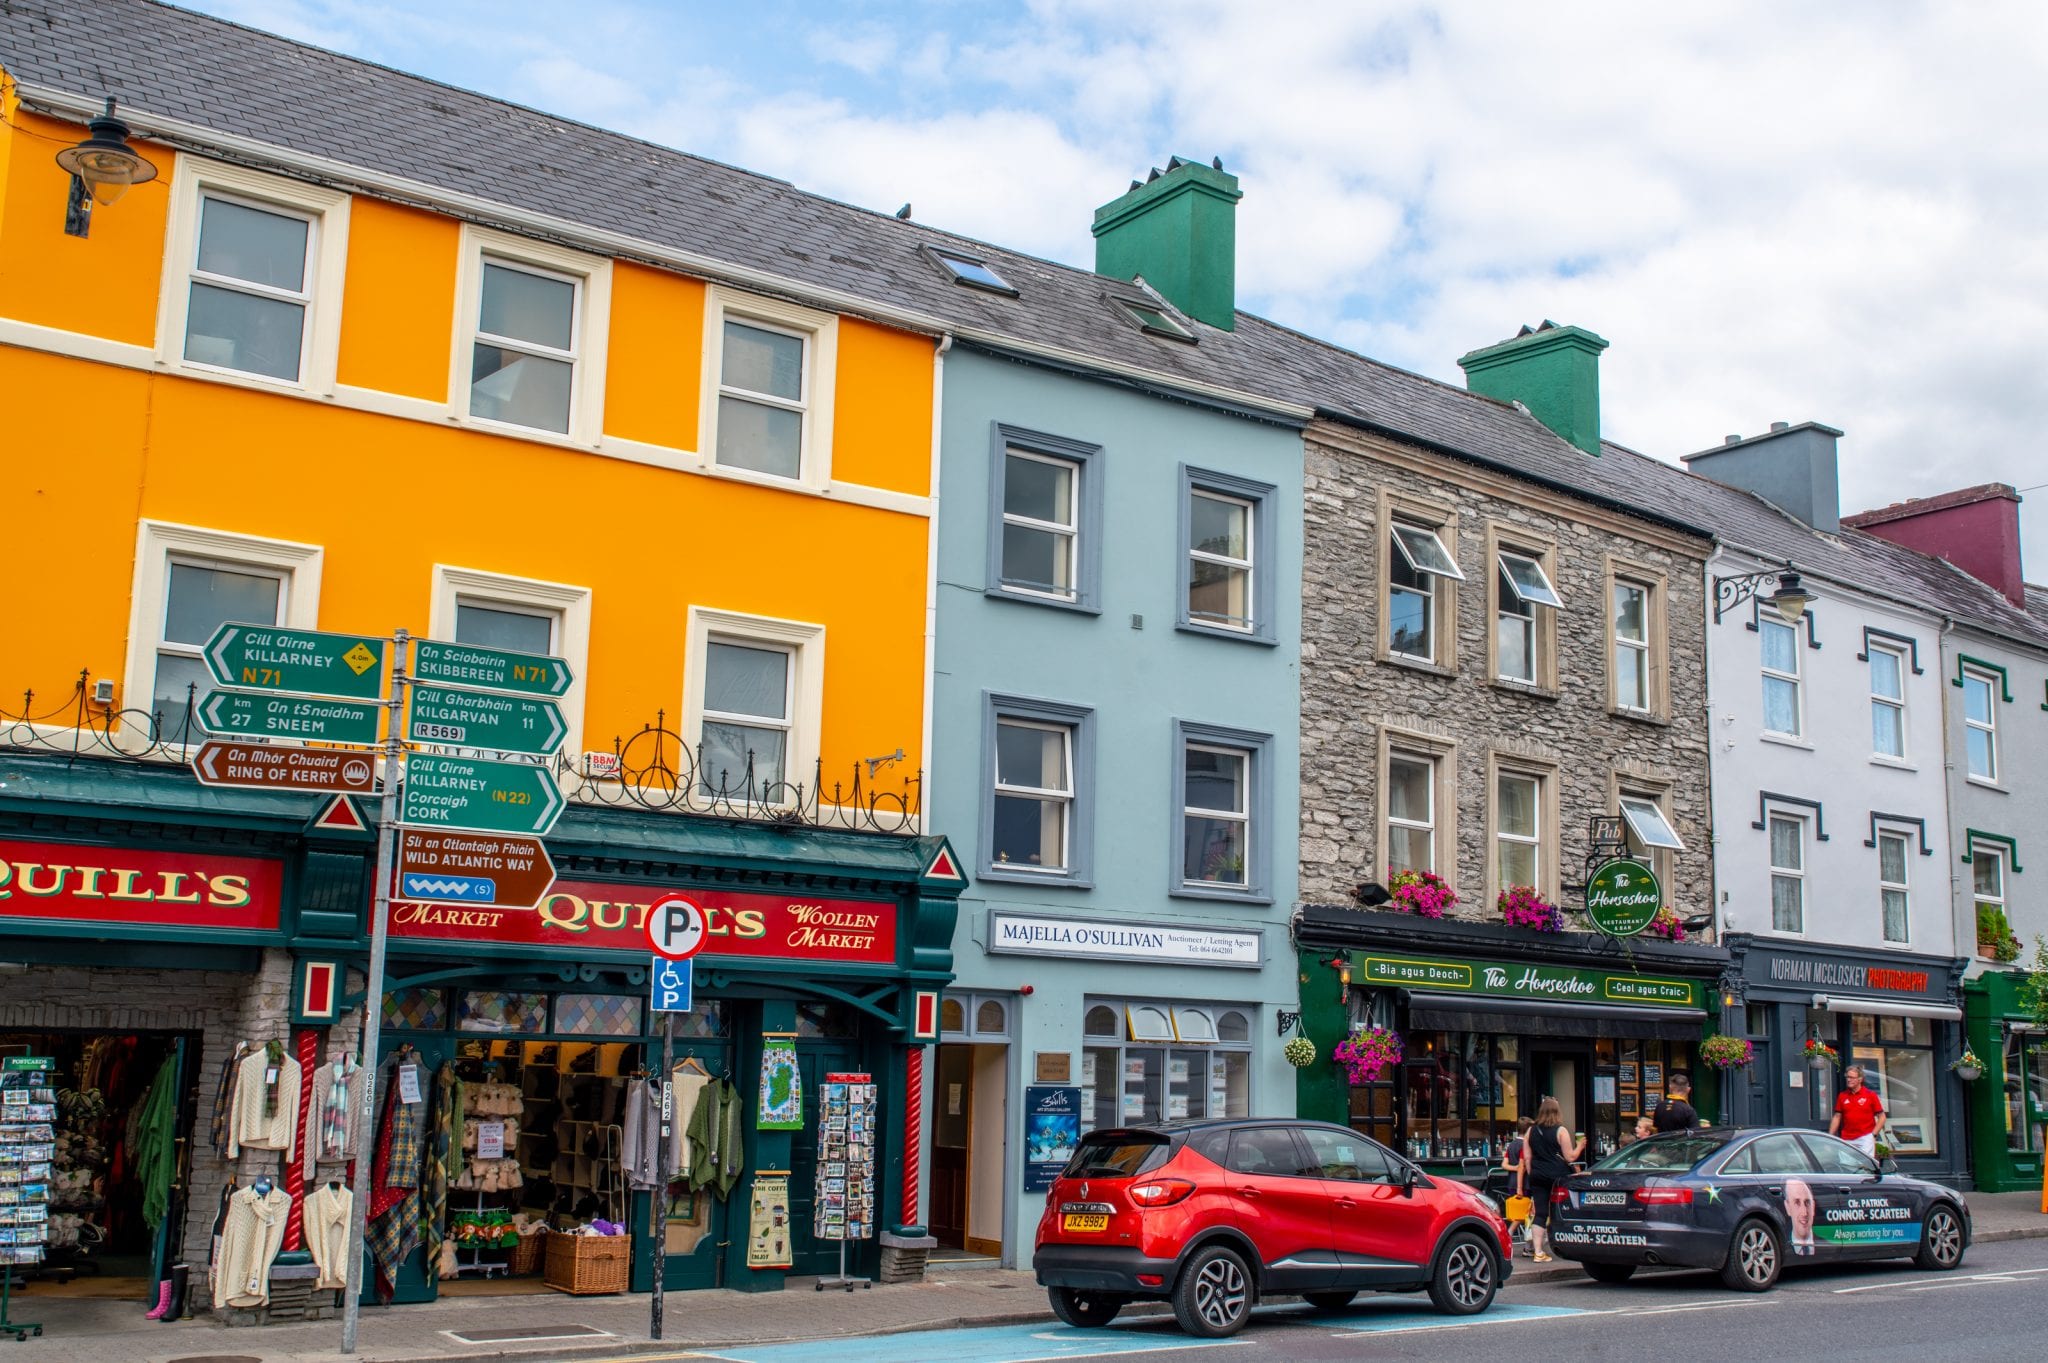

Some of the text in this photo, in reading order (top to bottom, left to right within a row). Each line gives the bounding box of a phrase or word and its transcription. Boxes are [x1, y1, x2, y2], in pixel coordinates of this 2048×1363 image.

[245, 634, 315, 650] Cill Airne
[244, 650, 333, 667] KILLARNEY
[352, 654, 369, 662] 4.0m
[421, 646, 438, 658] An
[421, 662, 504, 682] SKIBBEREEN
[234, 698, 251, 708] km
[417, 690, 512, 712] Cill Gharbháin
[522, 703, 537, 712] km
[268, 701, 364, 720] An tSnaidhm
[416, 706, 499, 725] KILGARVAN
[231, 714, 251, 726] 27
[266, 718, 324, 733] SNEEM
[522, 718, 534, 730] 11
[228, 749, 246, 761] An
[288, 753, 339, 768] Chuaird
[593, 756, 615, 764] BBM
[228, 765, 337, 784] RING OF KERRY
[410, 759, 474, 776] Cill Airne
[410, 774, 487, 792] KILLARNEY
[408, 791, 468, 809] Corcaigh
[407, 806, 450, 821] CORK
[1595, 822, 1621, 839] Pub
[406, 836, 534, 856] Slí an Atlantaigh Fhiáin
[406, 851, 534, 872] WILD ATLANTIC WAY
[1614, 874, 1630, 889] The
[474, 884, 490, 896] (S)
[1589, 891, 1658, 908] Horseshoe
[537, 894, 766, 939] QUIL'S
[1602, 918, 1644, 926] RESTAURANT
[664, 906, 690, 947] P
[1003, 924, 1164, 948] MAJELLA O'SULLIVAN
[1167, 934, 1202, 944] Auctioneer
[1210, 937, 1232, 947] Letting
[1234, 939, 1253, 948] Agent
[1401, 966, 1425, 980] agus
[1770, 958, 1929, 992] NORMAN MCCLOSKEY PHOTOGRAPHY
[1483, 967, 1595, 995] The Horseshoe
[1638, 986, 1658, 996] agus
[663, 991, 679, 1009] P
[1861, 1199, 1889, 1207] PATRICK
[1870, 1208, 1911, 1220] SCARTEEN
[1067, 1216, 1105, 1228] JXZ 9982
[1587, 1226, 1618, 1234] PATRICK
[1834, 1229, 1856, 1240] Always
[1857, 1230, 1881, 1240] working
[1882, 1228, 1891, 1237] for
[1596, 1235, 1647, 1245] SCARTEEN
